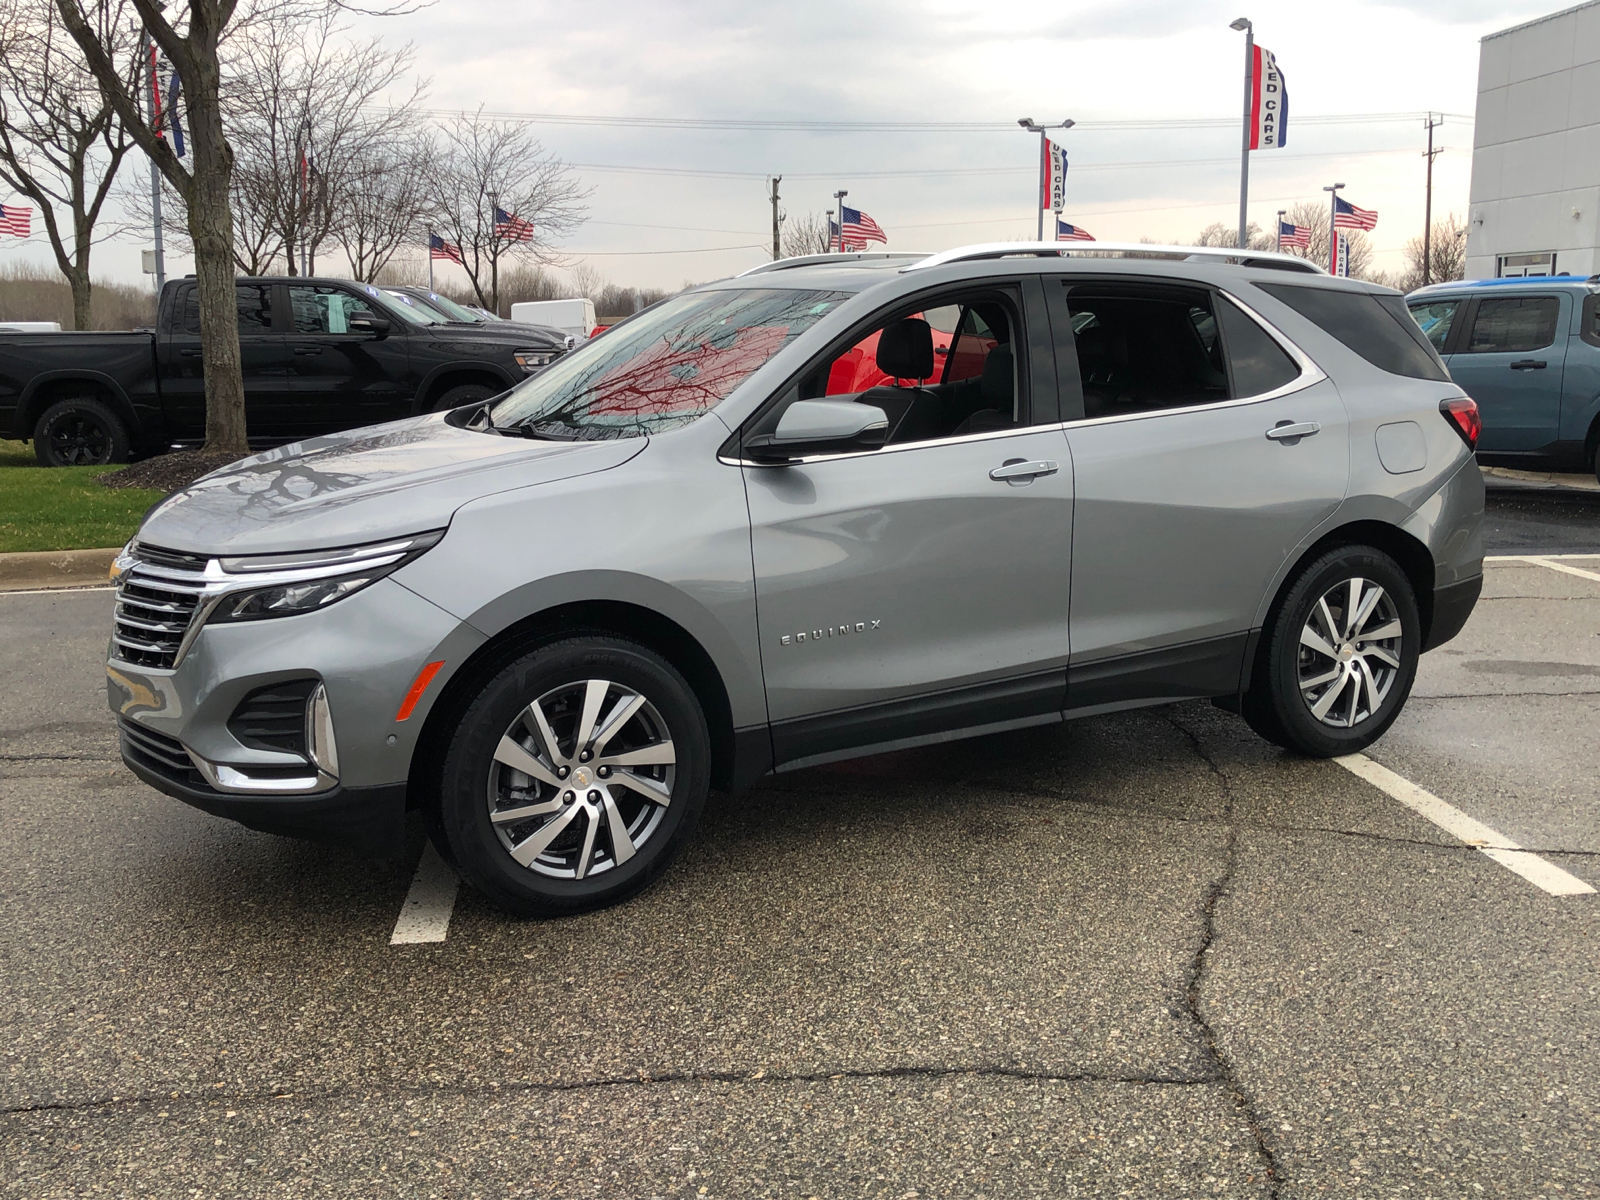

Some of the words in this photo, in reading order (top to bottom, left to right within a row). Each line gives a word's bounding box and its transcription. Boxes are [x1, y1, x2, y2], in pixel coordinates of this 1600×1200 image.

[1264, 100, 1276, 145] CARS
[1054, 176, 1062, 208] CARS
[781, 619, 881, 646] EQUINOX
